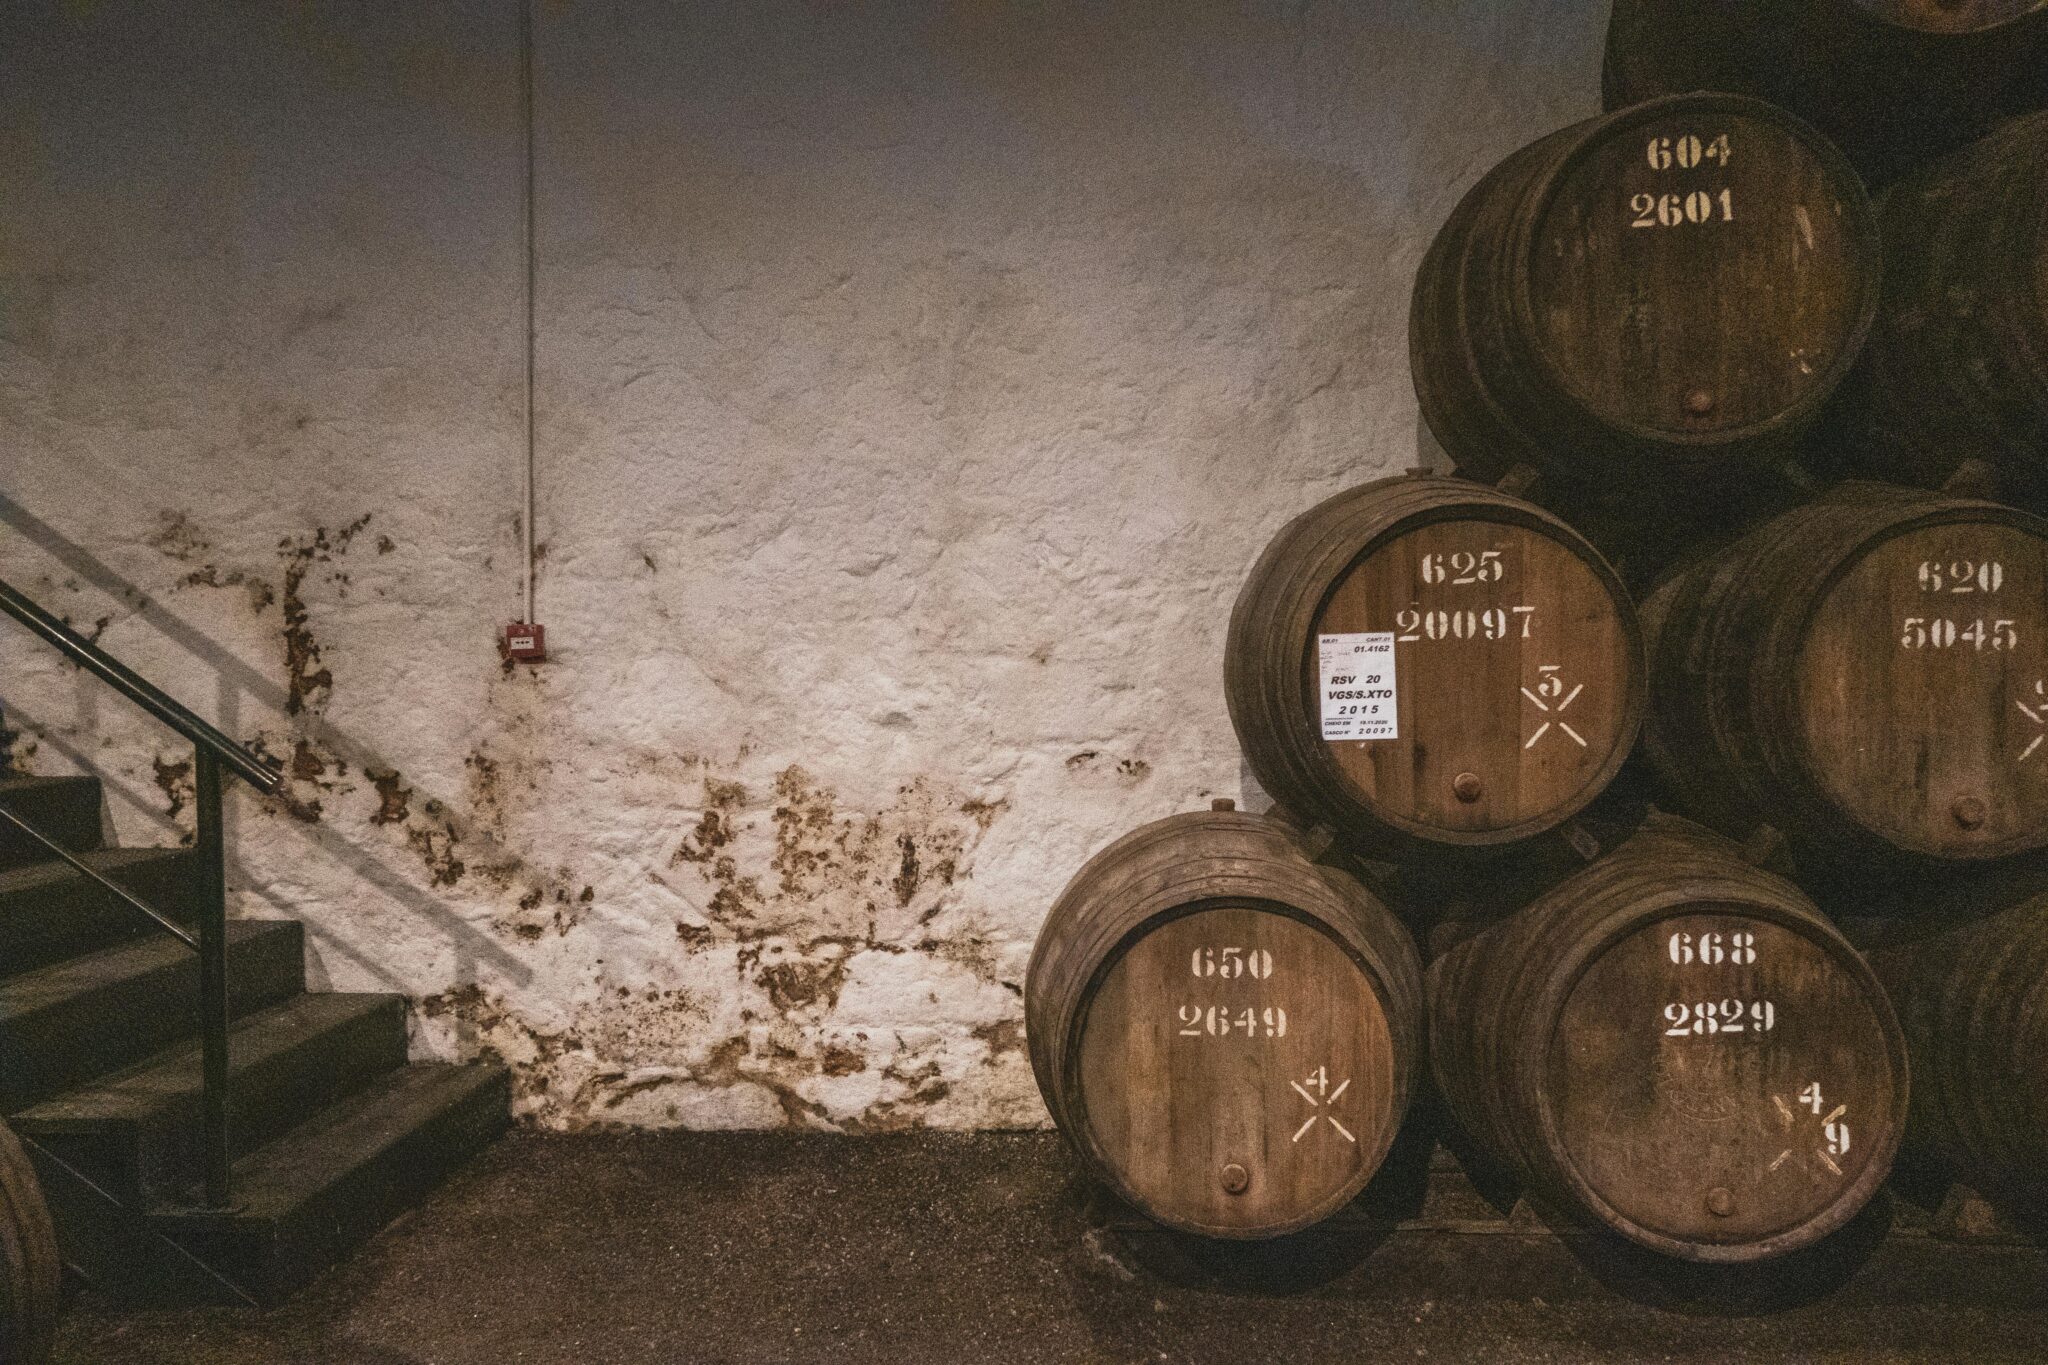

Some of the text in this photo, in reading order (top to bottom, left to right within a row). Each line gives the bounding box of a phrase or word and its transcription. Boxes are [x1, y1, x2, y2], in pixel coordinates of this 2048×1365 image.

[1647, 134, 1732, 170] 604
[1630, 188, 1734, 228] 2601
[1421, 550, 1504, 585] 625
[1918, 561, 2003, 593] 620
[1395, 605, 1536, 642] 20097
[1900, 617, 2018, 651] 5045
[1354, 645, 1390, 653] 01.4162
[1328, 689, 1393, 700] VGS/S.XTO
[1331, 674, 1381, 685] RSV 20
[1537, 665, 1562, 697] 5
[1338, 704, 1380, 715] 2015
[1191, 947, 1274, 980] 650
[1668, 932, 1757, 965] 668
[1178, 1005, 1288, 1038] 2649
[1663, 998, 1775, 1037] 2829
[1305, 1065, 1329, 1097] 4
[1797, 1081, 1823, 1115] 4
[1823, 1121, 1851, 1155] 9
